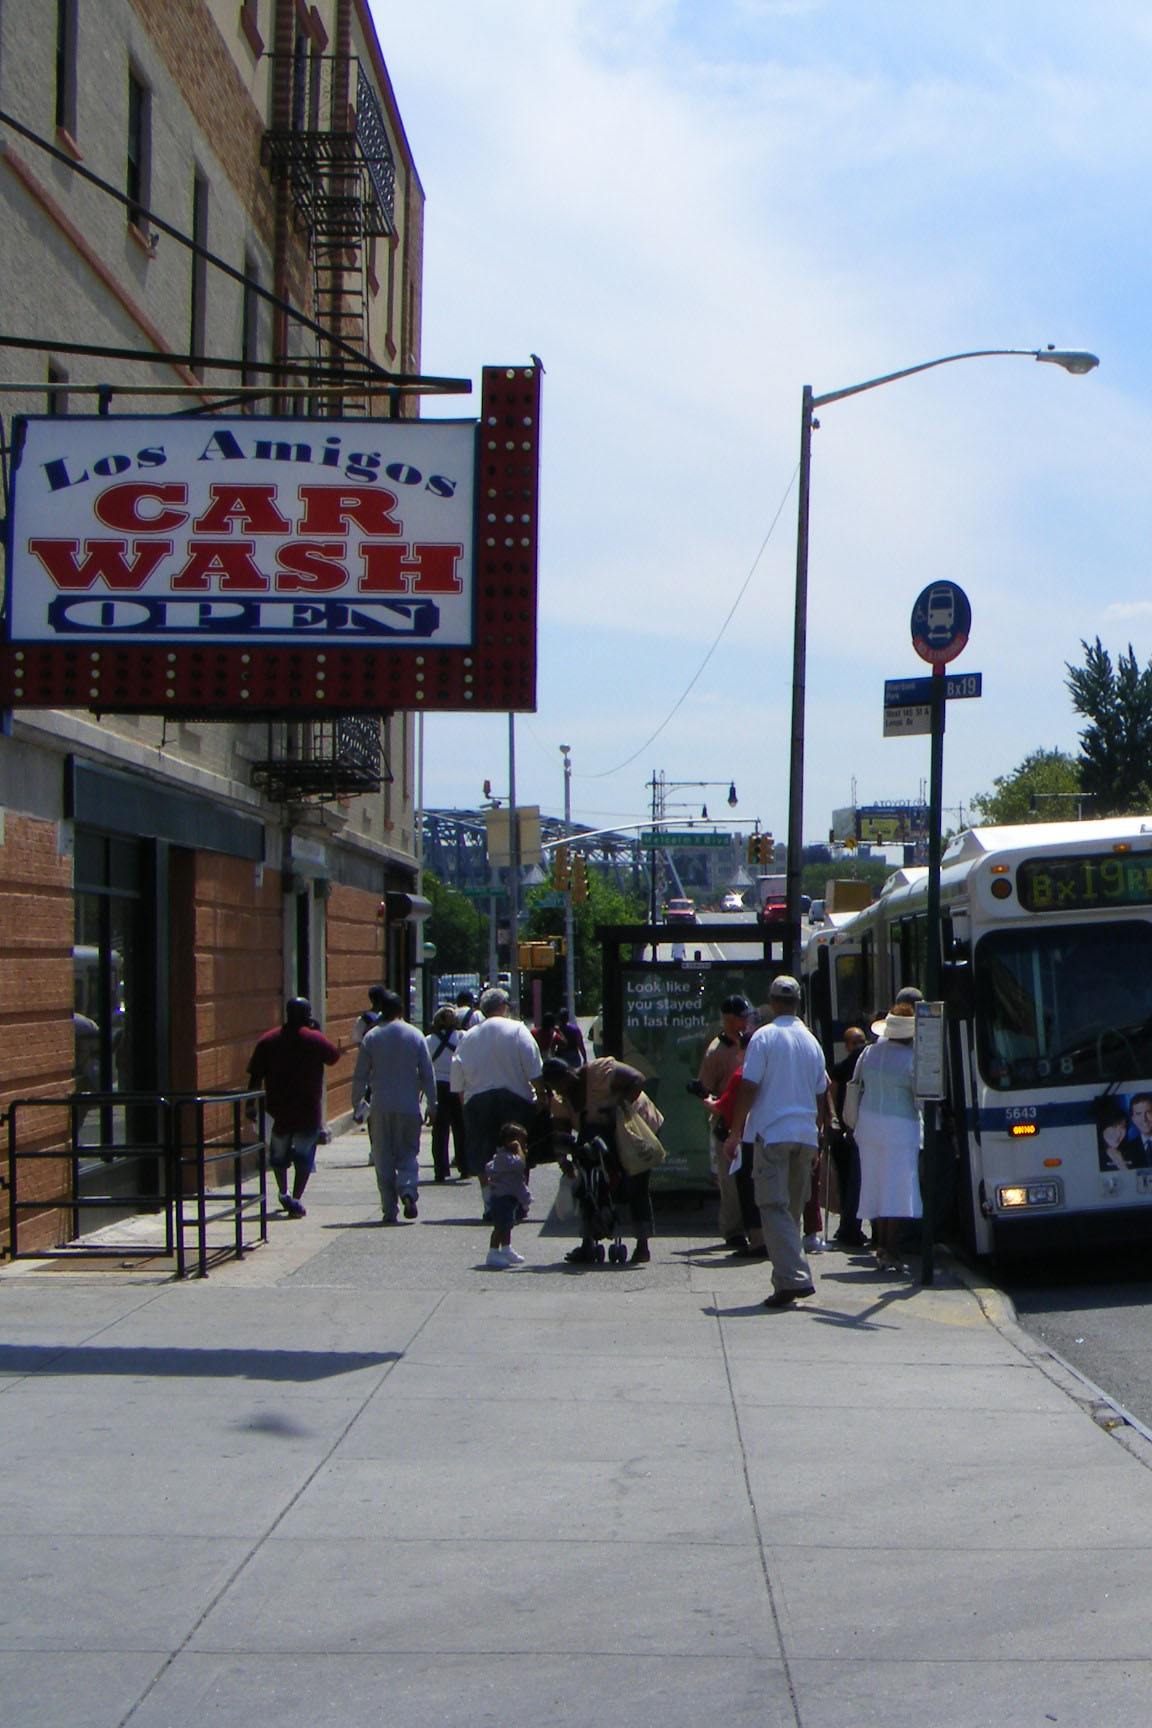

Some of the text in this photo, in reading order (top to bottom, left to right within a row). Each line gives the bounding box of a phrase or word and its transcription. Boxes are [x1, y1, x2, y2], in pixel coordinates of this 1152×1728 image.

[40, 429, 457, 499] Los Amigos
[93, 481, 404, 537] CAR
[27, 537, 465, 594] WASH
[63, 600, 428, 631] OPEN
[1032, 858, 1125, 906] Bx19
[626, 981, 690, 993] Look like
[626, 997, 702, 1013] you stayed
[627, 1014, 709, 1029] in last night.
[1005, 1107, 1037, 1120] 5643
